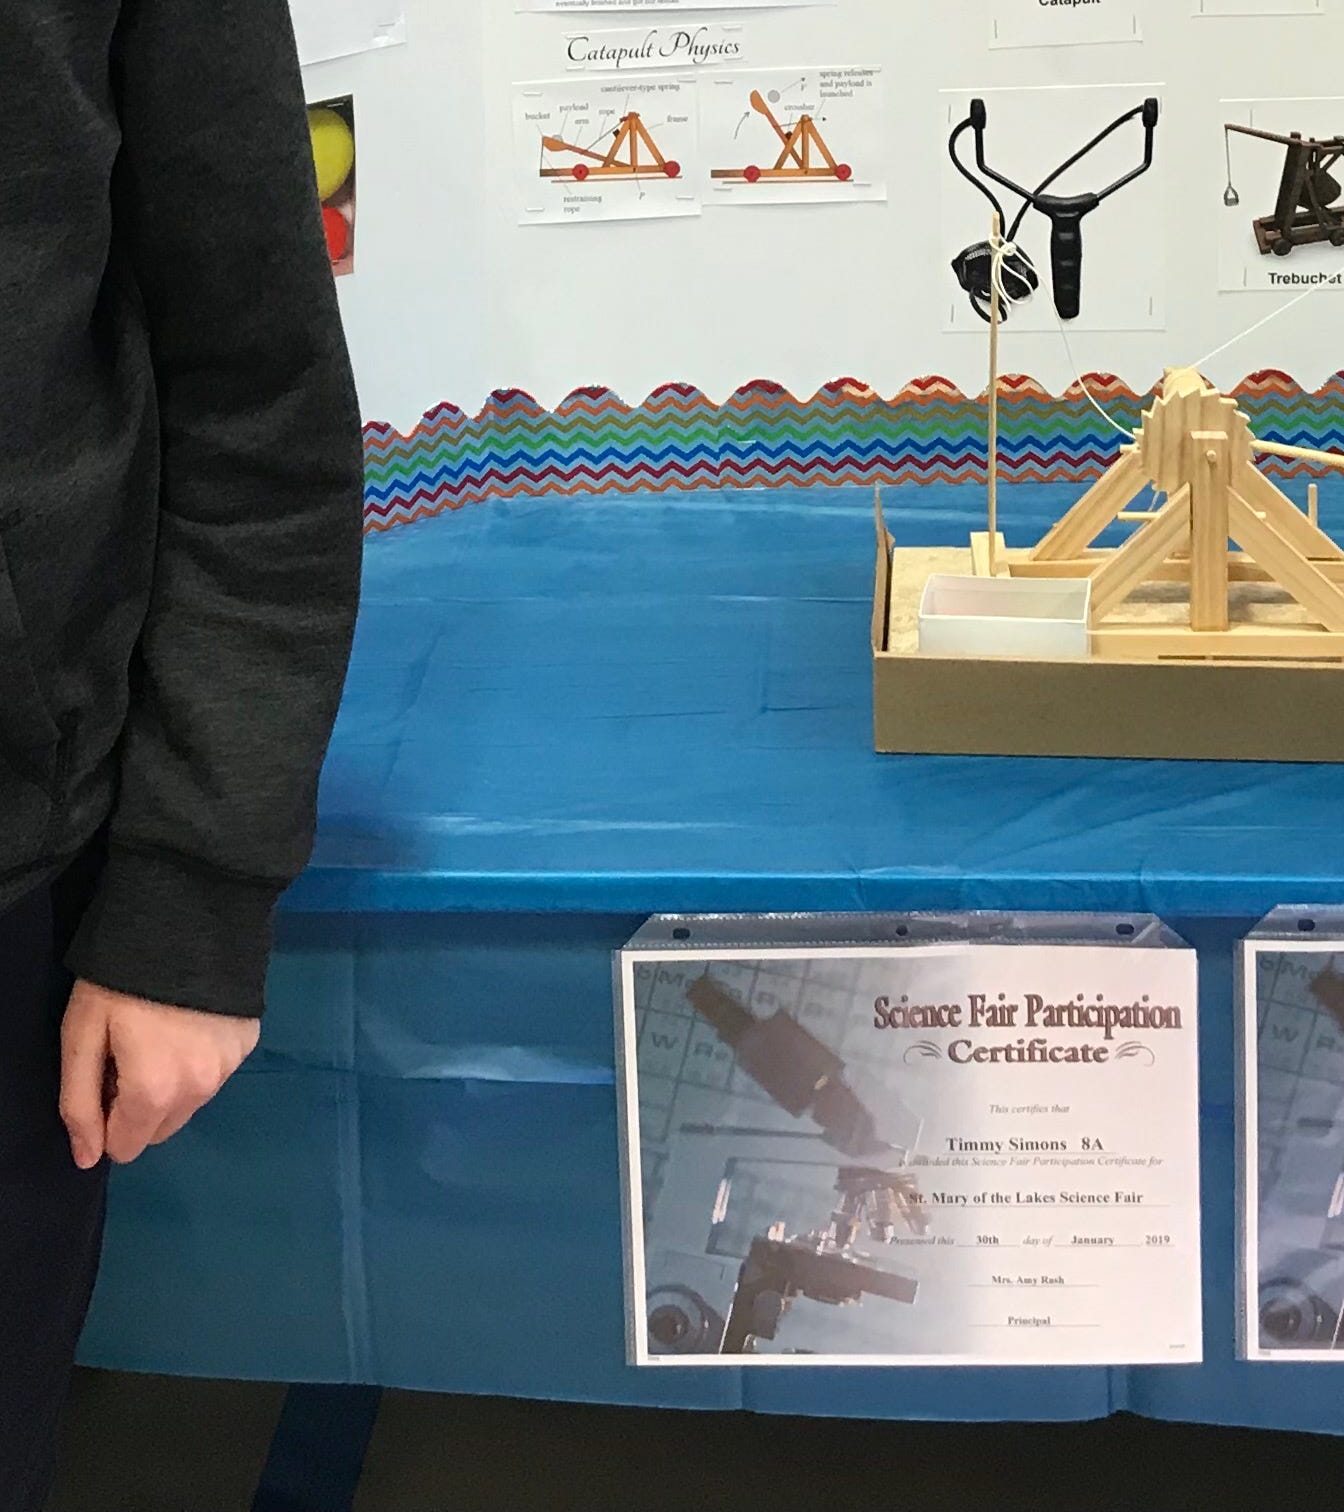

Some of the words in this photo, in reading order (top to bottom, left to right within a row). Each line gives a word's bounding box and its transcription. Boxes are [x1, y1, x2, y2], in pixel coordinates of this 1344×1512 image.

[567, 29, 657, 68] Catapult
[659, 26, 740, 64] Physics
[525, 111, 550, 120] bucket
[1268, 271, 1342, 285] Trebuchet
[873, 994, 962, 1030] Science
[967, 993, 1018, 1028] Fair
[1024, 993, 1182, 1040] Participation
[947, 1038, 1109, 1064] Certificate
[989, 1104, 1009, 1114] This
[1011, 1104, 1049, 1115] certifies
[1052, 1104, 1070, 1114] that
[946, 1137, 1003, 1154] Timmy
[1009, 1137, 1067, 1151] Simons
[1081, 1137, 1105, 1151] 8A
[951, 1156, 969, 1167] this
[971, 1156, 1007, 1167] Science
[1009, 1156, 1030, 1167] Fair
[1033, 1156, 1095, 1168] Participation
[1097, 1155, 1146, 1167] Certificate
[1148, 1155, 1164, 1168] for
[909, 1192, 927, 1204] St.
[932, 1192, 967, 1207] Mary
[973, 1191, 988, 1204] of
[990, 1191, 1011, 1204] the
[1015, 1192, 1055, 1204] Lakes
[1059, 1192, 1110, 1204] Science
[1115, 1192, 1144, 1204] Fair
[938, 1235, 954, 1246] this
[976, 1235, 1000, 1245] 30th
[1022, 1235, 1040, 1247] day
[1041, 1235, 1053, 1247] of
[1070, 1235, 1114, 1248] January
[1145, 1235, 1170, 1245] 2019
[992, 1275, 1012, 1285] Mrs.
[1016, 1275, 1038, 1286] Amy
[1040, 1275, 1064, 1285] Rush
[1008, 1316, 1051, 1328] Principal
